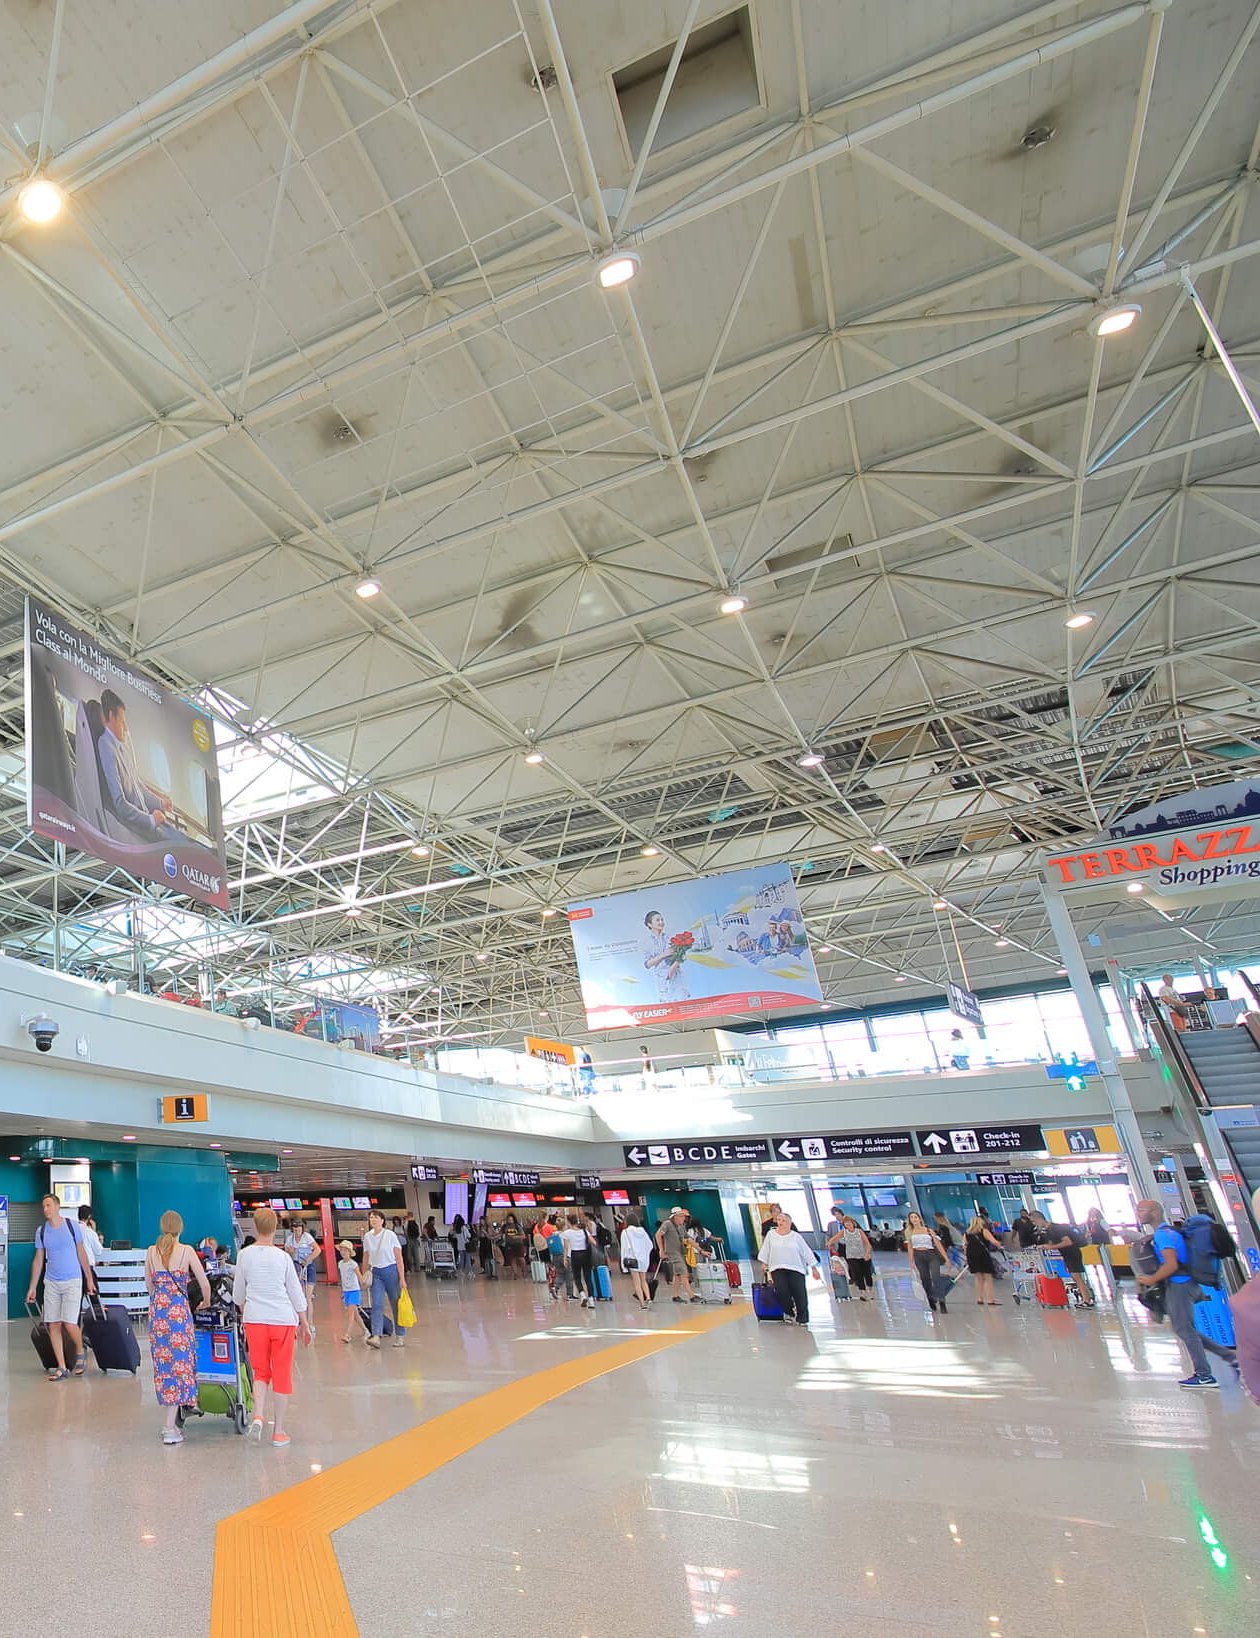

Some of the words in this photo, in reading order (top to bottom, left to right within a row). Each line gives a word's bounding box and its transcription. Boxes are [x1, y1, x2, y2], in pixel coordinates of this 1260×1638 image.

[35, 628, 61, 655] Class
[62, 647, 73, 663] al
[74, 651, 108, 684] Mondo
[35, 609, 57, 636] Vola
[59, 629, 77, 649] con
[79, 638, 88, 656] la
[89, 645, 130, 681] Migliore
[127, 670, 162, 705] Business
[181, 864, 210, 888] QATAR
[1160, 859, 1260, 886] Shopping
[830, 1138, 863, 1147] Controlli
[873, 1136, 910, 1146] sicurezza
[983, 1131, 1021, 1141] Check-in
[735, 1144, 766, 1152] Imbarchi
[985, 1139, 1021, 1148] 201-212
[831, 1145, 863, 1155] Security
[863, 1144, 892, 1153] control
